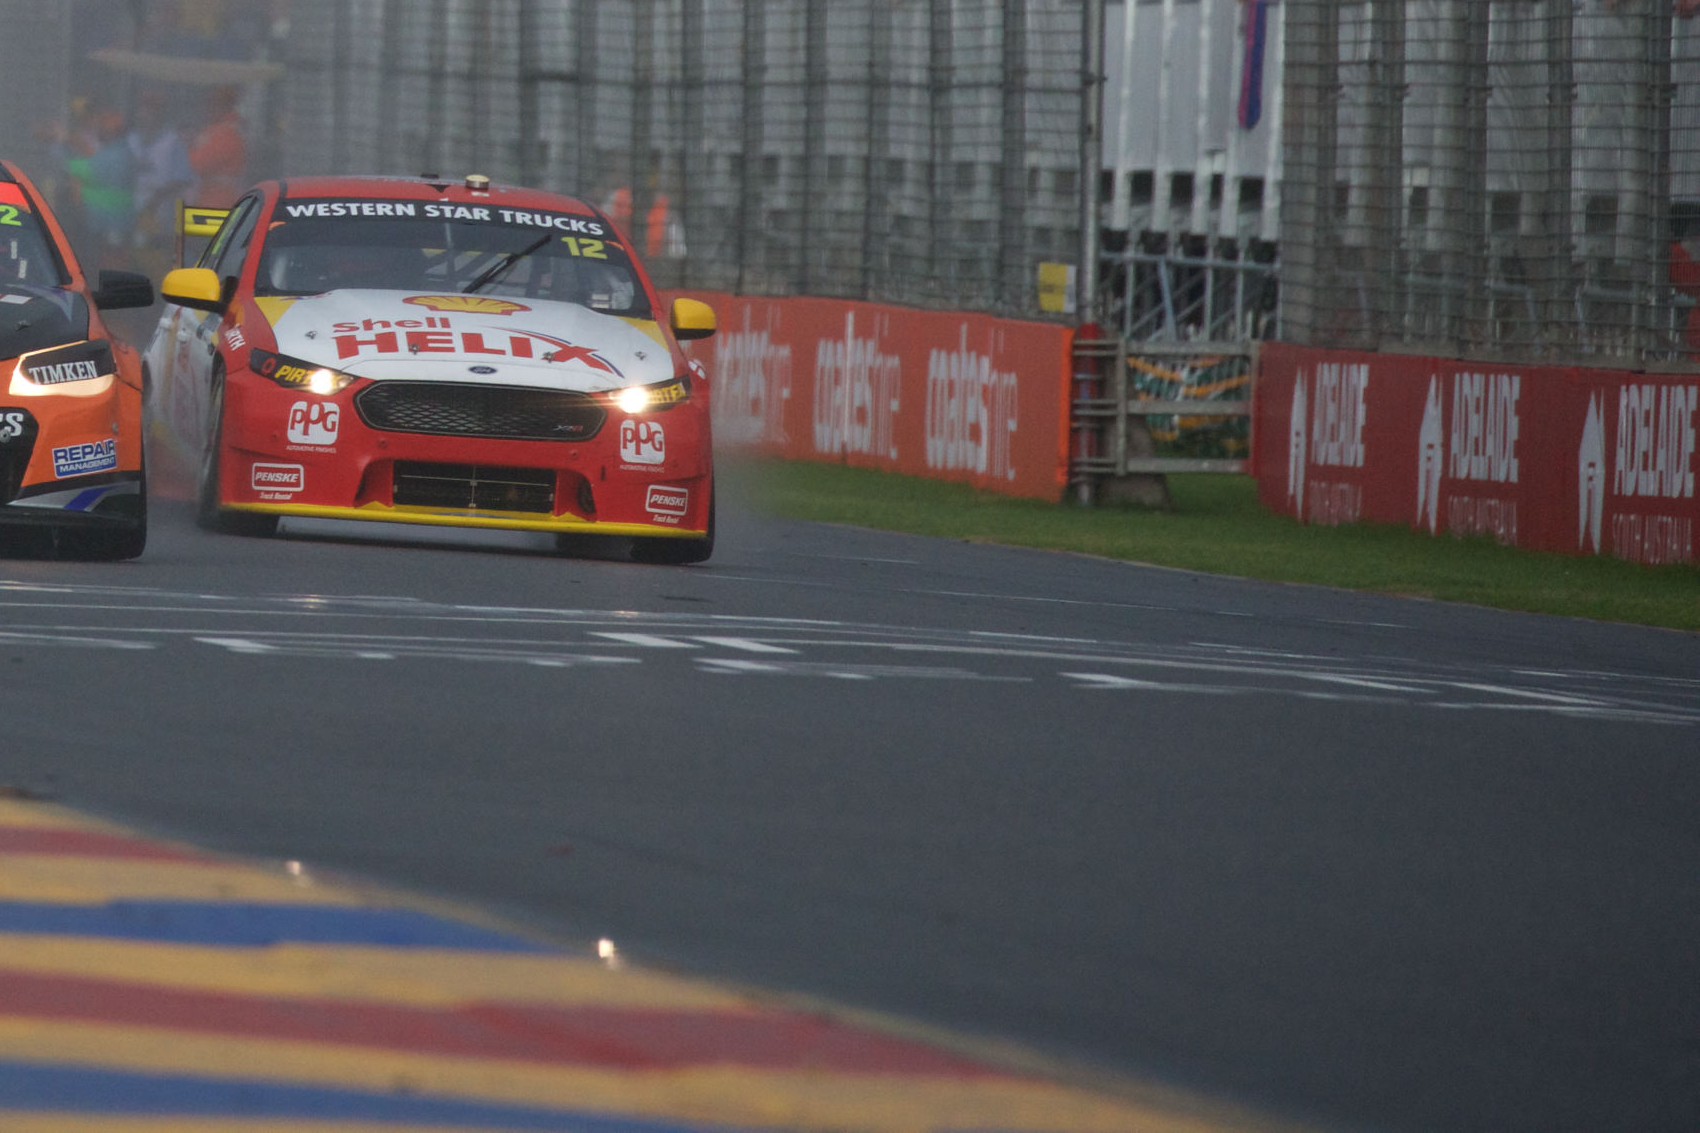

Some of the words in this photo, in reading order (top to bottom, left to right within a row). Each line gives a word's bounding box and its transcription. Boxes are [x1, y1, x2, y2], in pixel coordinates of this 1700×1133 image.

[286, 202, 416, 218] WESTERN
[424, 204, 491, 221] STAR
[498, 209, 605, 236] TRUCKS
[560, 237, 609, 260] 12
[332, 331, 615, 374] HELIX
[29, 360, 98, 384] TIMKEN
[289, 403, 338, 436] PPG
[1449, 372, 1520, 483] ADELAIDE
[54, 440, 116, 463] REPAIR
[622, 420, 664, 455] PPG
[1613, 384, 1698, 498] ADELAIDE
[59, 457, 116, 473] MANAGEMENT
[255, 472, 299, 483] PENSKE
[650, 493, 686, 507] PENSKE
